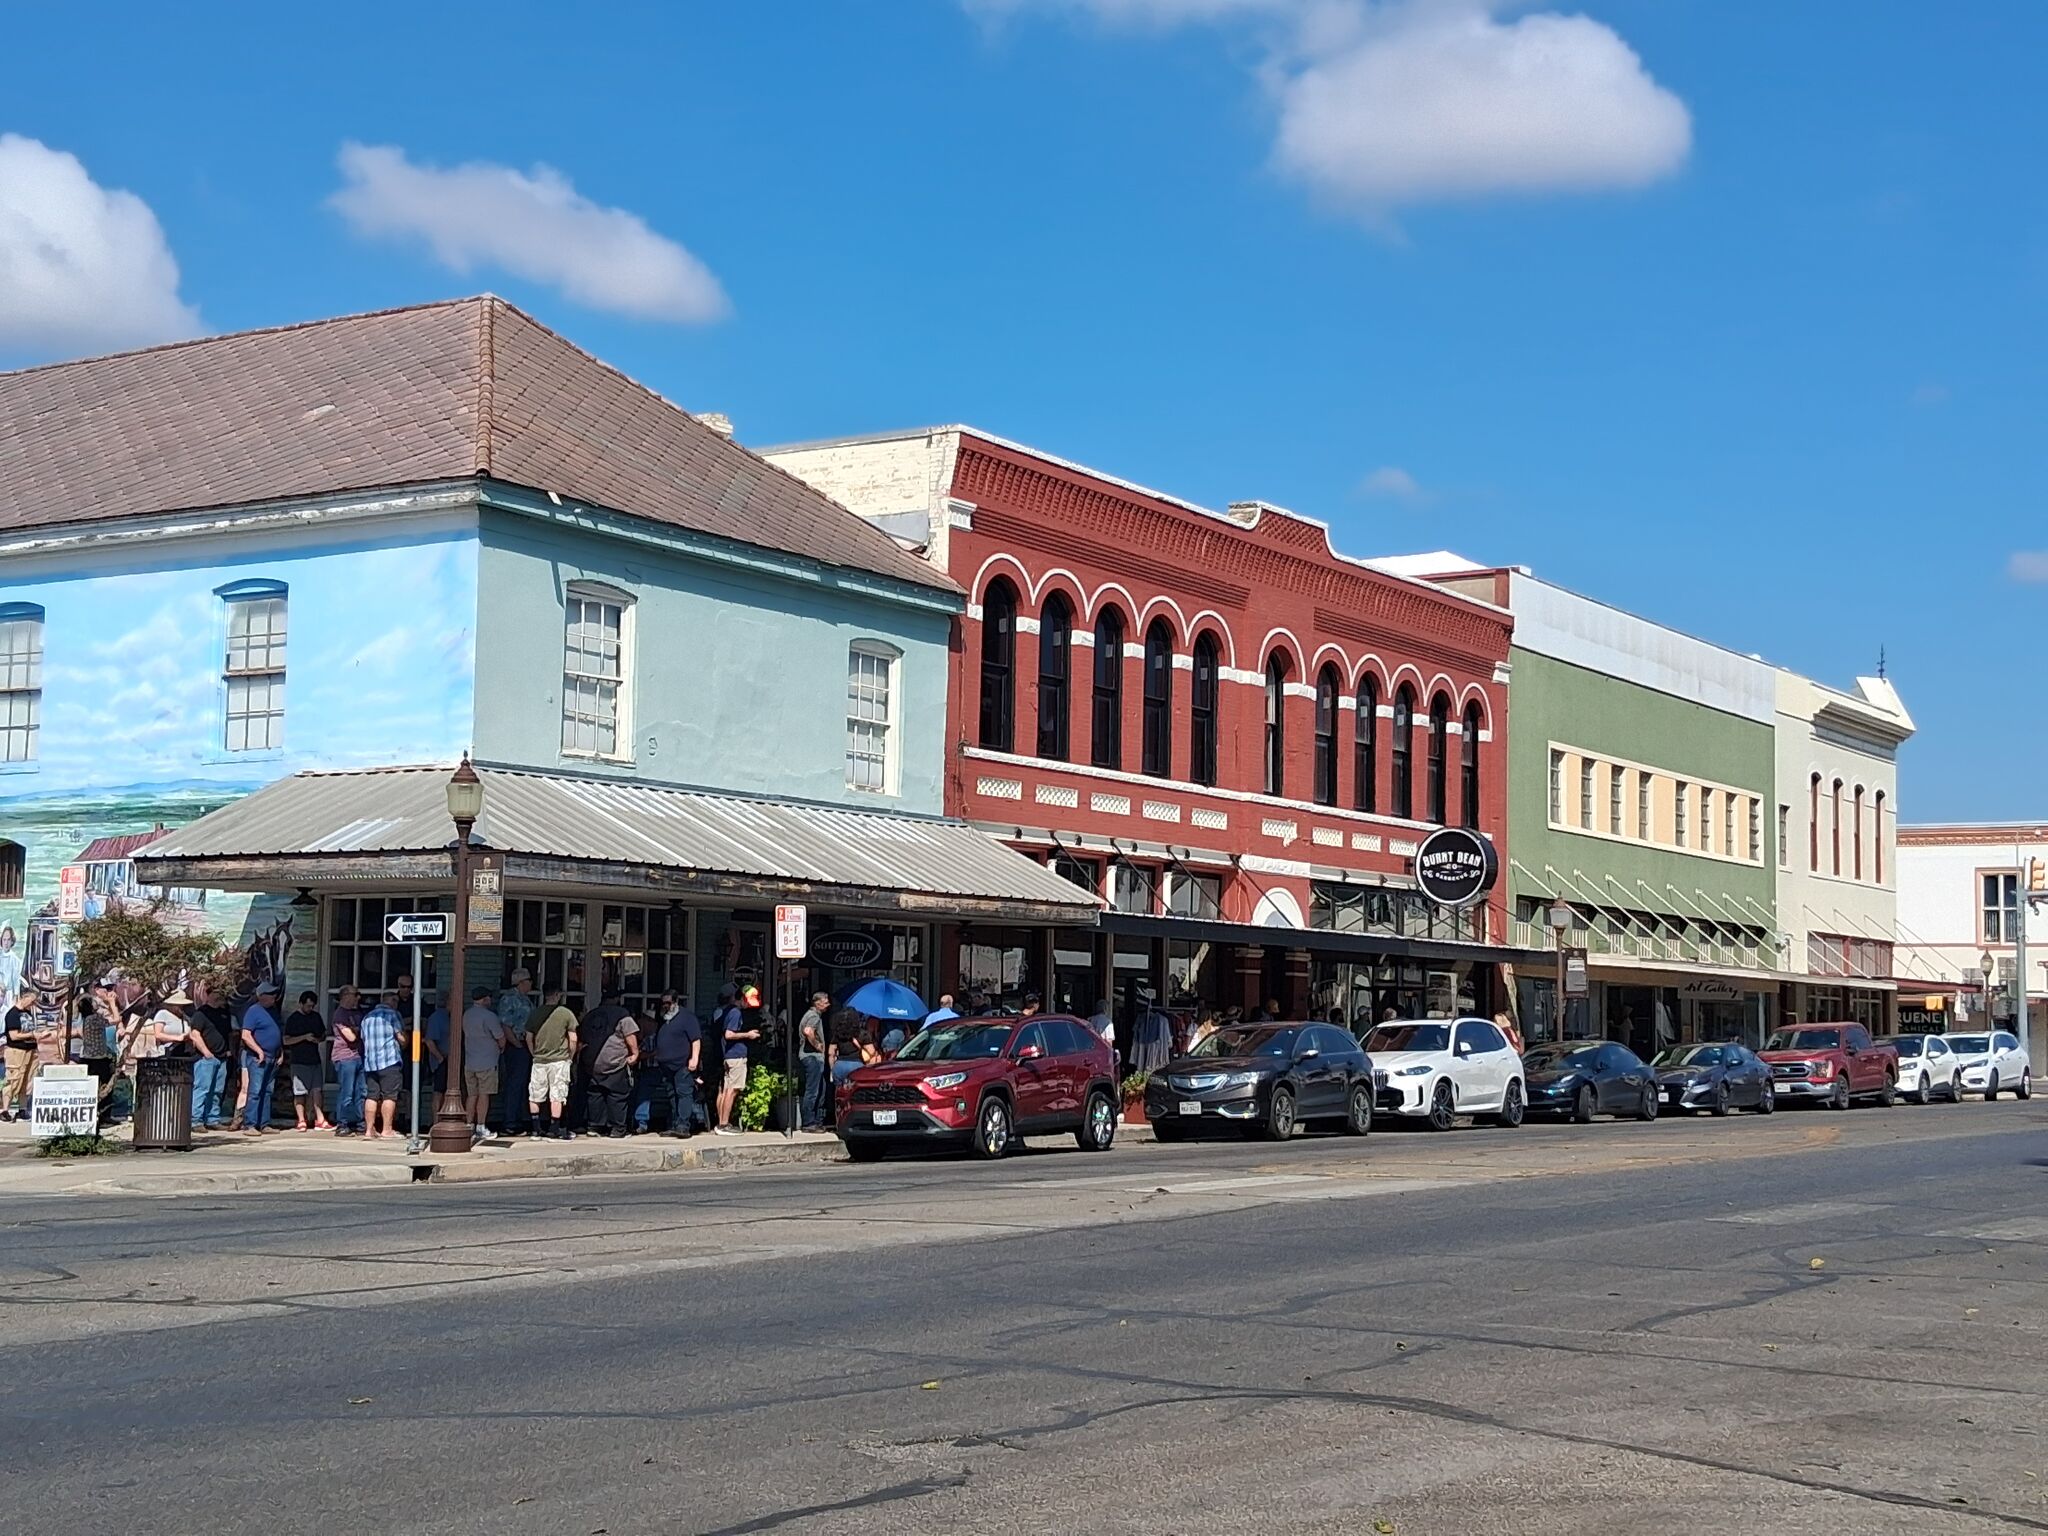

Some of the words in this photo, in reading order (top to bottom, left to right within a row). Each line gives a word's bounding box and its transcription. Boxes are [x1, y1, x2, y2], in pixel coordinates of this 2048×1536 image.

[1422, 851, 1453, 867] BURNT
[1457, 851, 1481, 867] BEAN
[402, 923, 419, 934] ONE
[421, 923, 440, 934] WAY
[783, 924, 799, 934] M-F
[783, 936, 799, 946] 8-5
[814, 941, 873, 951] SOUTHERN
[834, 949, 869, 965] Good
[35, 1098, 62, 1106] FARMER
[69, 1097, 96, 1105] ARTISAN
[35, 1106, 95, 1124] MARKET
